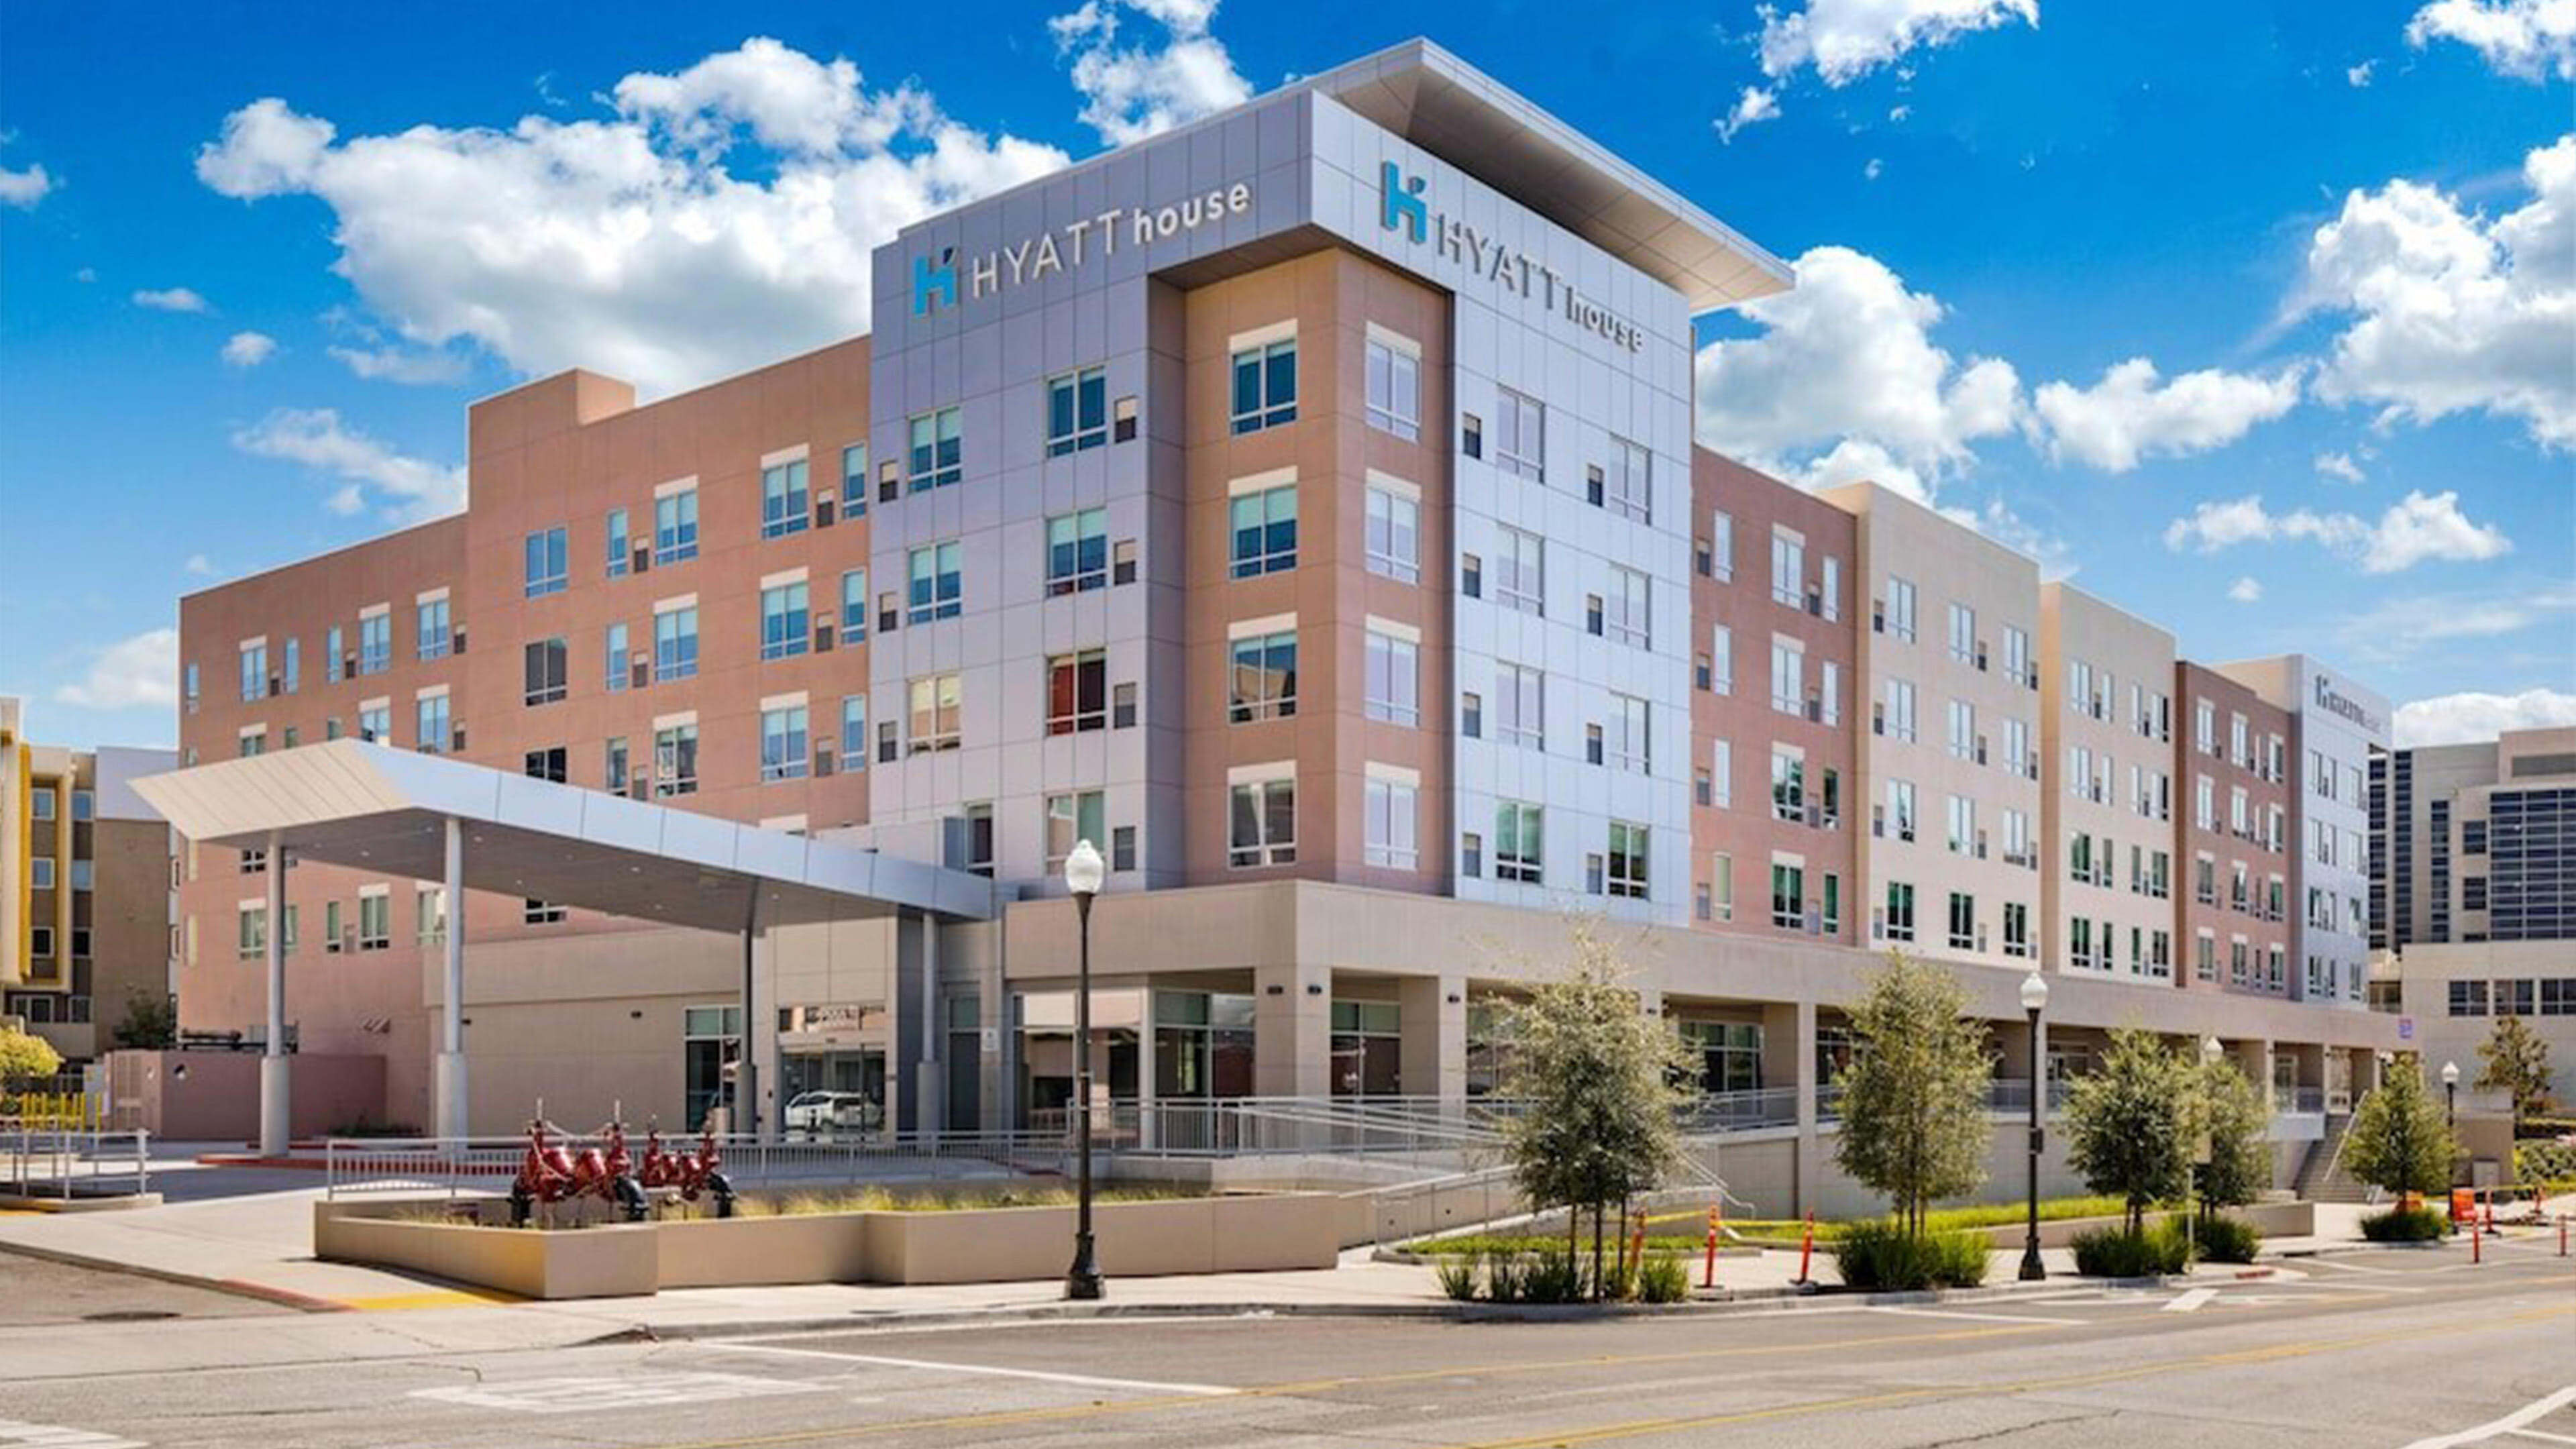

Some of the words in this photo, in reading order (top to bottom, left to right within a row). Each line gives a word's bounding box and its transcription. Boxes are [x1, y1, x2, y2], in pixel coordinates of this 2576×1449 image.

[972, 209, 1121, 299] HYATT
[1134, 182, 1249, 244] house
[1439, 213, 1561, 310] HYATT
[1566, 286, 1643, 352] house
